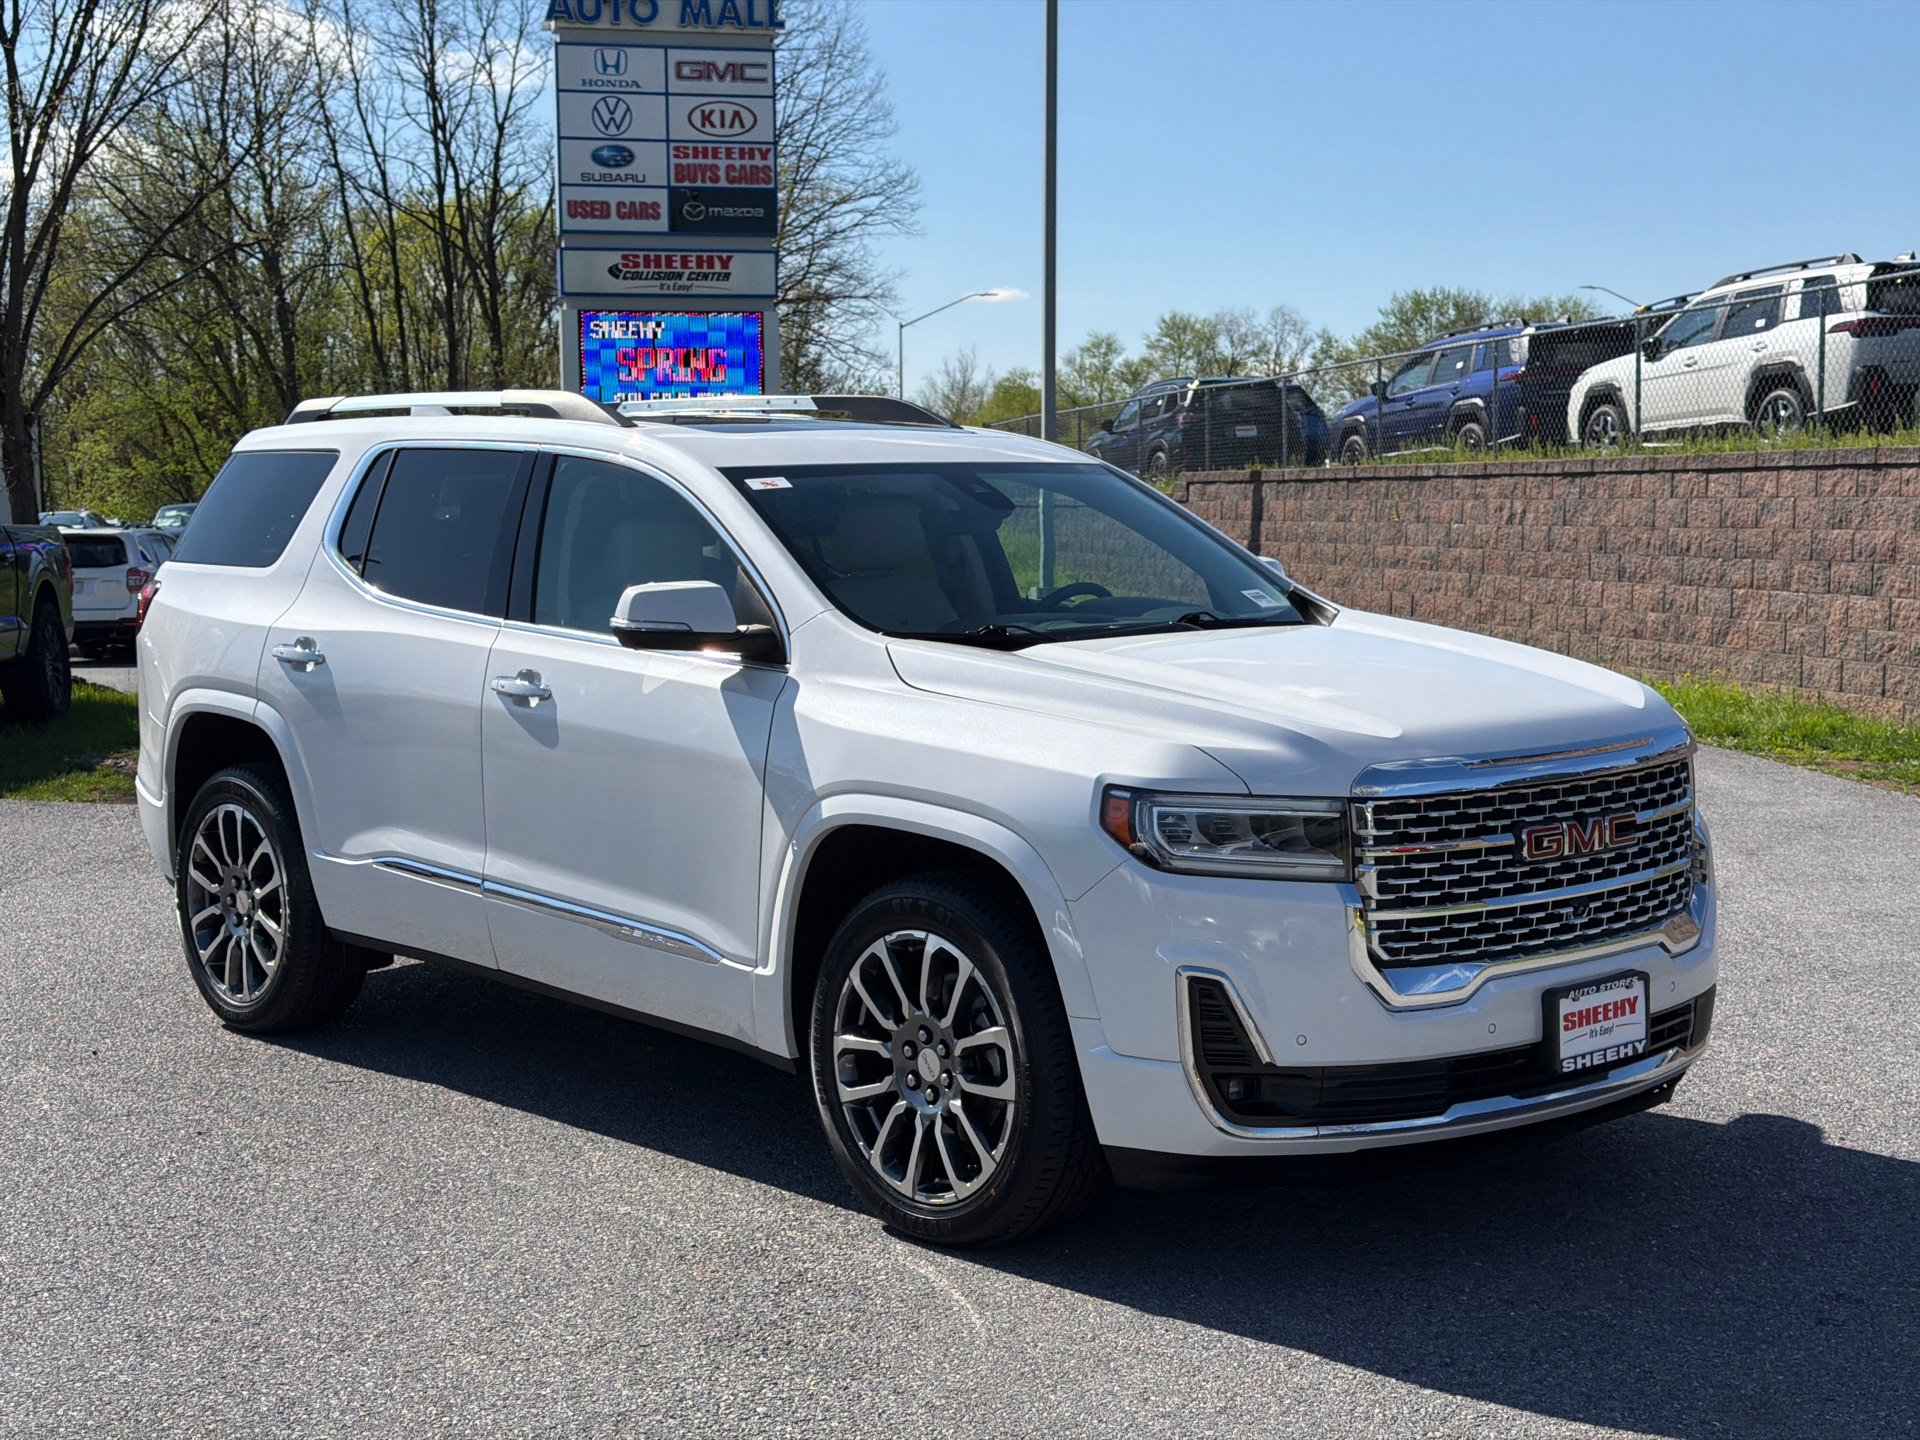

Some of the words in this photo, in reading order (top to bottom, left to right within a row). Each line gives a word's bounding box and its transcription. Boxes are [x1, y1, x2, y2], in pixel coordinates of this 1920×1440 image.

[545, 0, 660, 25] AUTO
[678, 0, 786, 28] MALL
[674, 60, 768, 84] GMC
[580, 78, 642, 89] HONDA
[700, 109, 746, 130] KIA
[672, 145, 772, 161] SHEEHY
[580, 172, 646, 183] SUBARU
[674, 163, 720, 184] BUYS
[725, 164, 773, 185] CARS
[566, 200, 611, 219] USED
[616, 201, 662, 221] CARS
[621, 253, 734, 270] SHEEHY
[622, 270, 685, 281] COLLISION
[686, 271, 732, 281] CENTER
[659, 282, 671, 291] It's
[671, 282, 694, 293] Easy!
[589, 320, 665, 339] SHEEHY
[1521, 810, 1638, 861] GMC
[1567, 985, 1597, 1000] AUTO
[1562, 995, 1639, 1032] SHEEHY
[1589, 1028, 1598, 1039] It's
[1599, 1022, 1615, 1036] Easy!
[1562, 1039, 1647, 1073] SHEEHY
